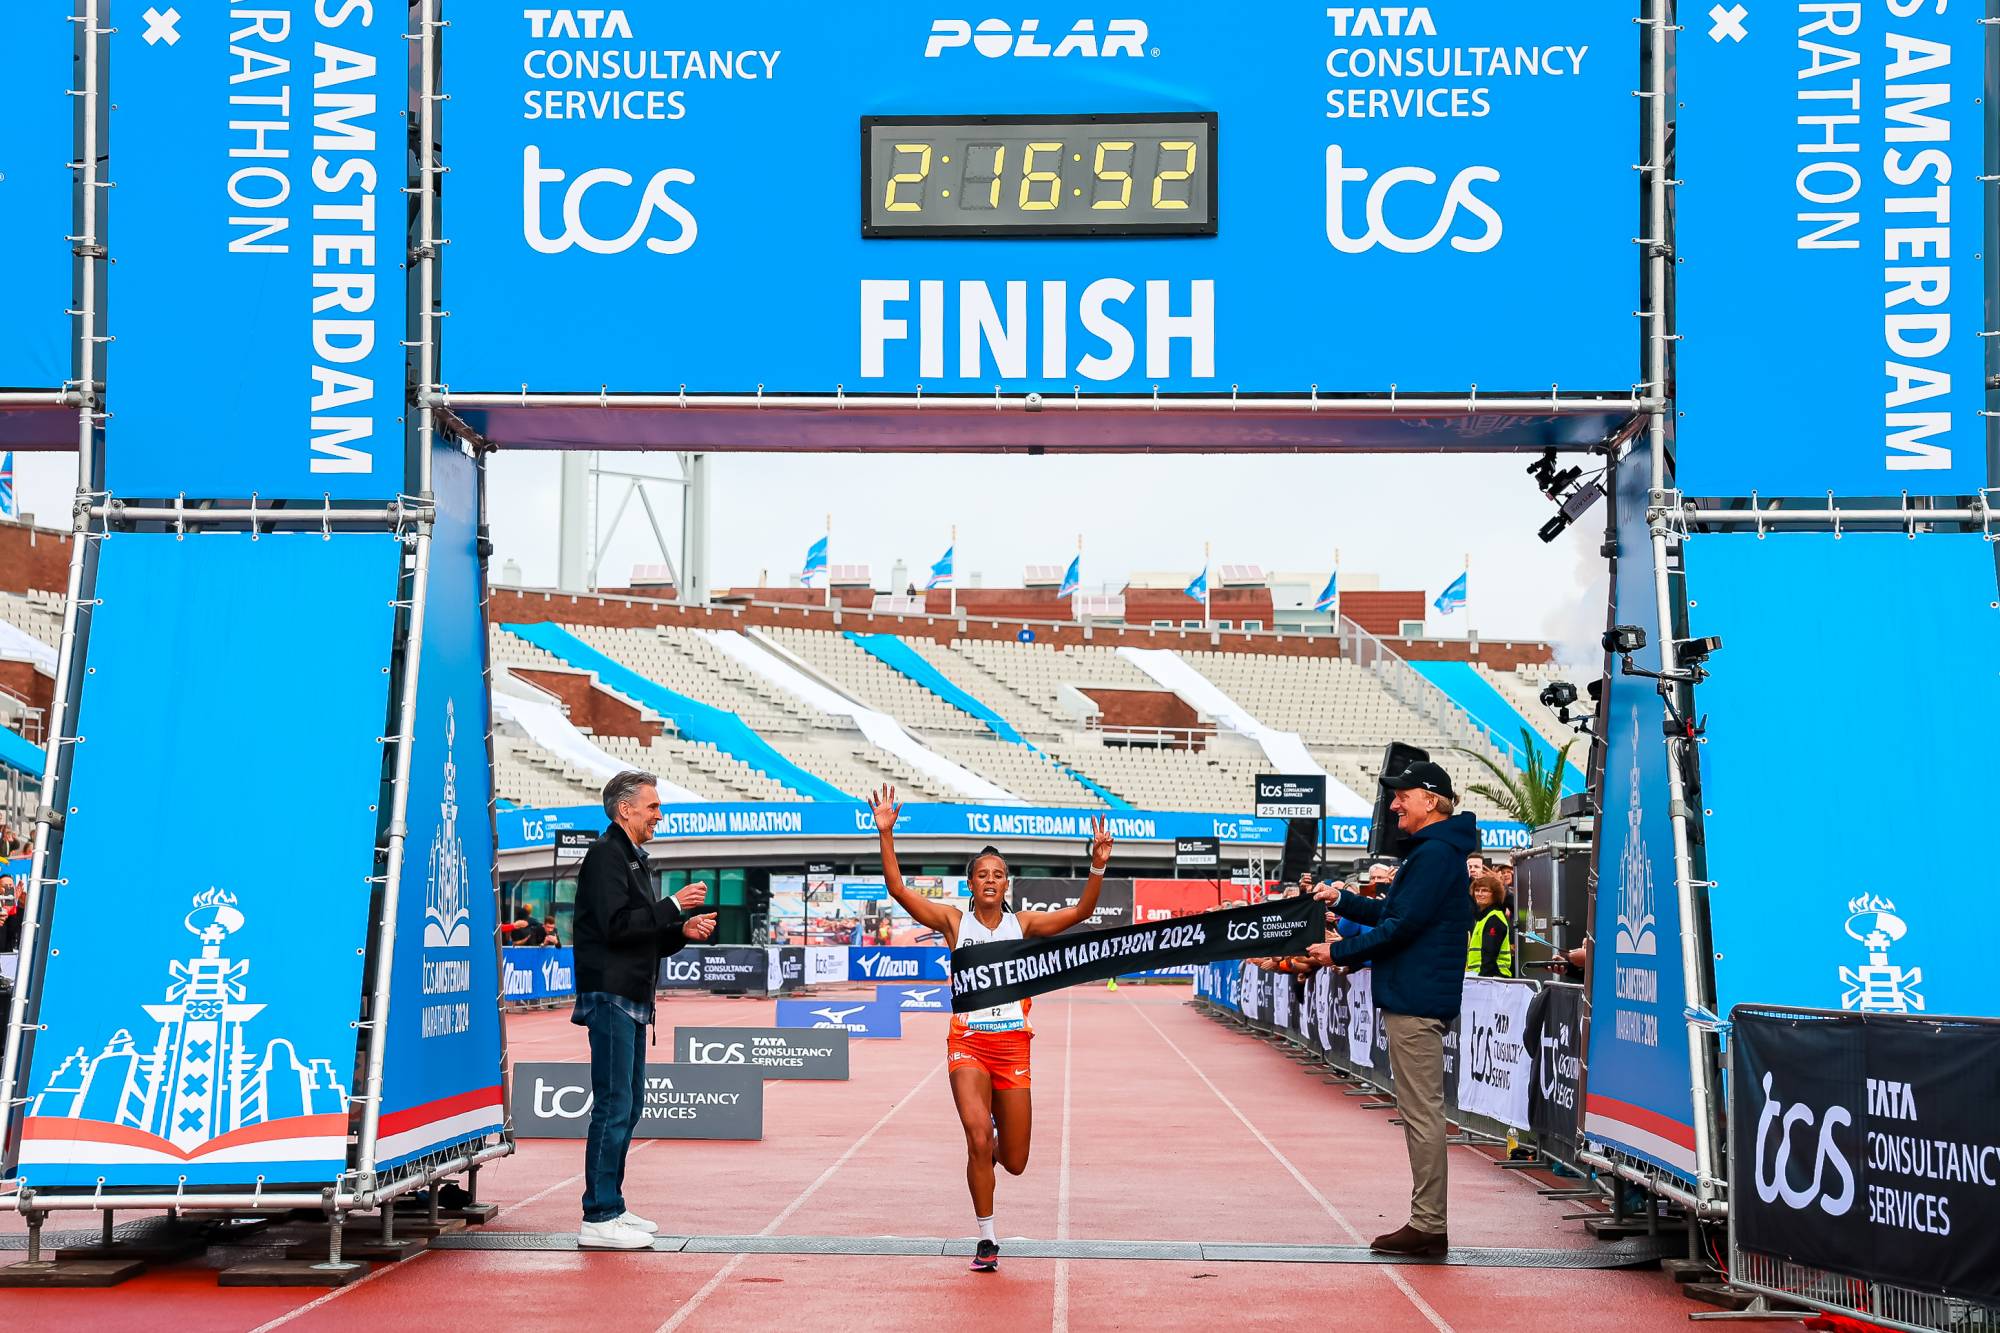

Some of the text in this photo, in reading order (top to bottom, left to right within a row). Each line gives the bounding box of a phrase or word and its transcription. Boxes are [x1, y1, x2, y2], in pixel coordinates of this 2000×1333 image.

[524, 10, 632, 38] TATA
[1327, 8, 1436, 36] TATA
[924, 18, 1149, 58] POLAR
[524, 50, 781, 80] CONSULTANCY
[1326, 46, 1588, 77] CONSULTANCY
[524, 90, 685, 120] SERVICES
[1326, 88, 1490, 118] SERVICES
[227, 0, 291, 254] RATHON
[524, 145, 698, 254] tcs
[1326, 144, 1503, 253] tcs
[309, 41, 377, 473] AMSTERDAM
[1885, 32, 1952, 470] AMSTERDAM
[860, 278, 1214, 381] FINISH
[654, 811, 801, 834] MSTERDAM MARATHON
[966, 813, 990, 832] TCS
[993, 815, 1076, 834] AMSTERDAM
[1262, 806, 1312, 816] 25 METER
[523, 816, 544, 841] tcs
[1213, 819, 1237, 838] tcs
[1332, 824, 1357, 842] TCS
[1481, 829, 1533, 847] RATHO
[1136, 905, 1143, 919] I
[1262, 915, 1282, 923] TATA
[1227, 920, 1259, 941] tcs
[1262, 920, 1308, 931] CONSULTANCY
[1263, 930, 1293, 938] SERVICES
[667, 957, 700, 981] tcs
[953, 924, 1206, 996] AMSTERDAM MARATHON 2024
[991, 1008, 1001, 1016] F2
[689, 1037, 745, 1064] tcs
[752, 1038, 787, 1046] TATA
[752, 1048, 832, 1057] CONSULTANCY
[752, 1058, 803, 1066] SERVICES
[645, 1078, 673, 1089] TA
[534, 1078, 594, 1118] tc
[644, 1093, 740, 1105] NSULTANCY
[1867, 1078, 1917, 1121] TATA
[640, 1107, 697, 1119] RVICES
[1755, 1071, 1854, 1216] tcs
[1868, 1184, 1950, 1236] SERVICES
